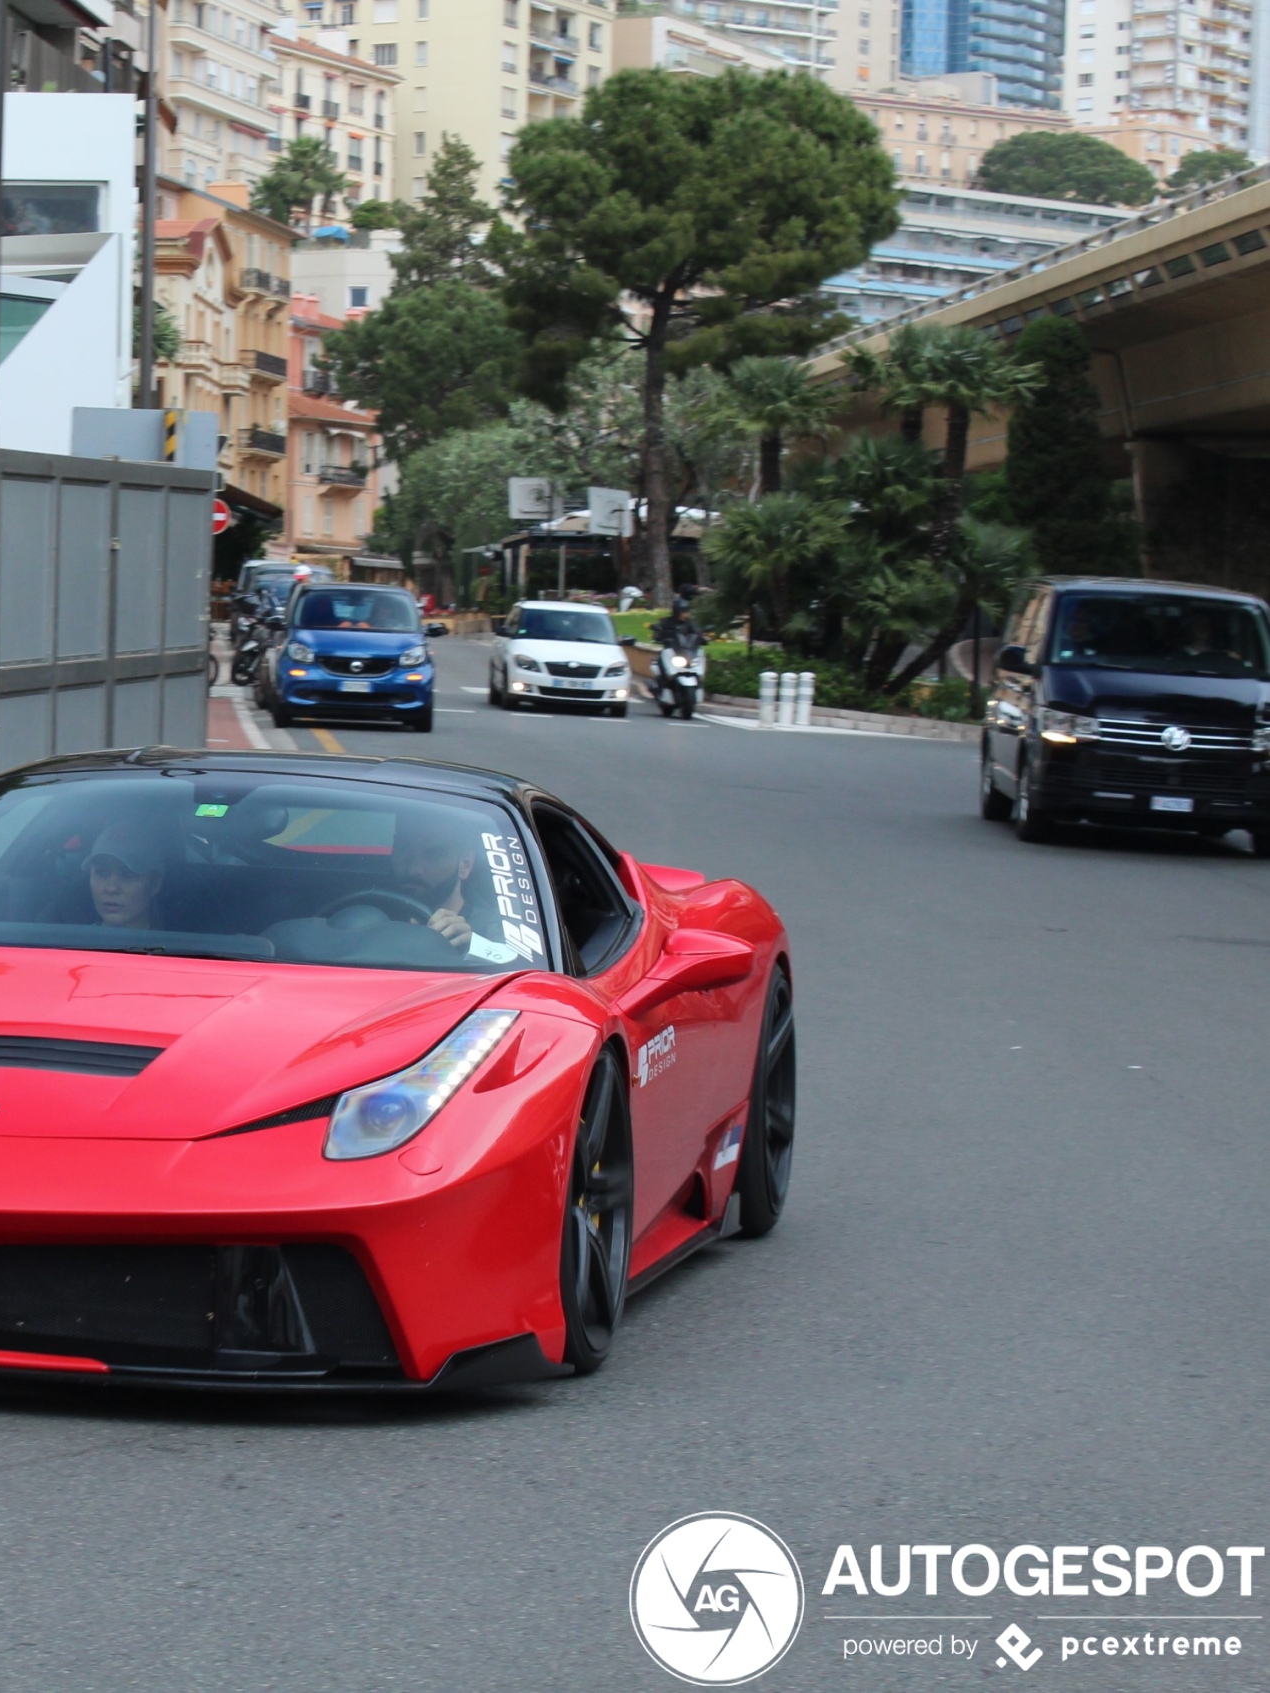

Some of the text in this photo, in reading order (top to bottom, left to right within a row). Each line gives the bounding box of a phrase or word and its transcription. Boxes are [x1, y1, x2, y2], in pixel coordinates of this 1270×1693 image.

[481, 832, 522, 920] PRIOR
[507, 836, 537, 924] DESIGN
[647, 1025, 676, 1065] PRIOR
[649, 1052, 676, 1081] DESIGN
